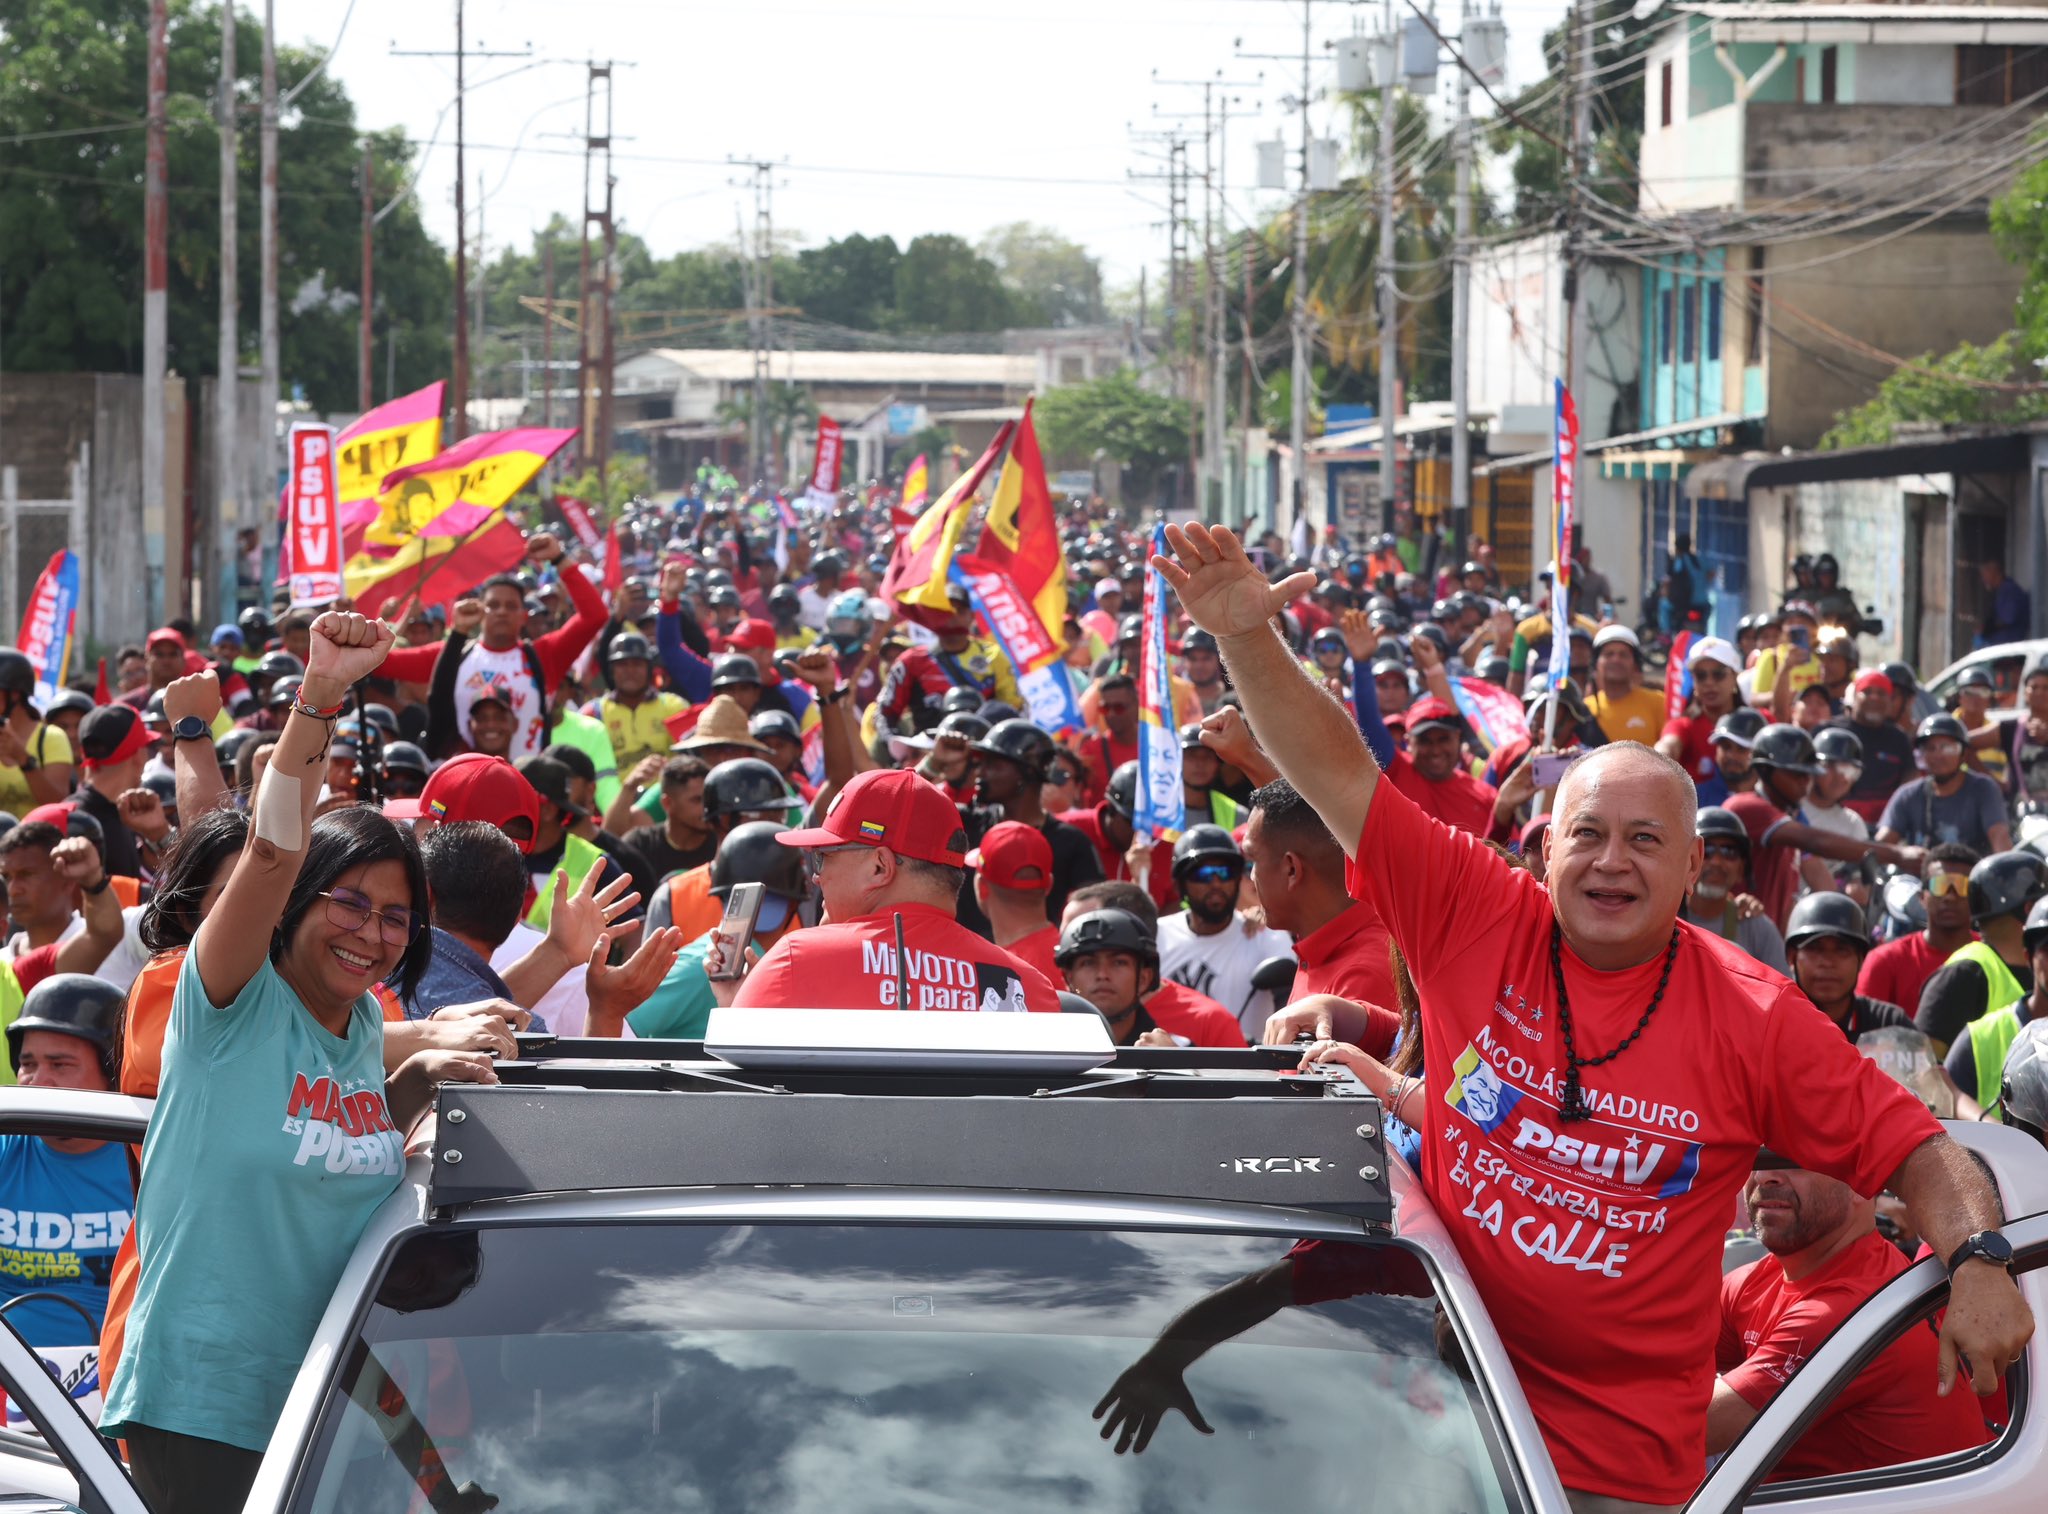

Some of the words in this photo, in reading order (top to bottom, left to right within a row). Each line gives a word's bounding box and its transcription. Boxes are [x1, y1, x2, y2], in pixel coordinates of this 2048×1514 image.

[862, 939, 898, 976] Mi
[904, 946, 976, 988] VOTO
[919, 983, 977, 1011] para
[281, 1116, 304, 1136] ES
[1578, 1087, 1700, 1133] MADURO
[1510, 1147, 1536, 1161] PARTIDO
[1538, 1158, 1572, 1175] SOCIALISTA
[1574, 1171, 1595, 1182] UNIDO
[1596, 1177, 1605, 1185] DE
[1606, 1182, 1642, 1193] VENEZUELA
[1462, 1180, 1504, 1237] LA
[1604, 1205, 1668, 1235] ESTÁ
[0, 1247, 56, 1265] VANTA
[58, 1252, 80, 1265] EL
[1511, 1216, 1631, 1278] CALLE
